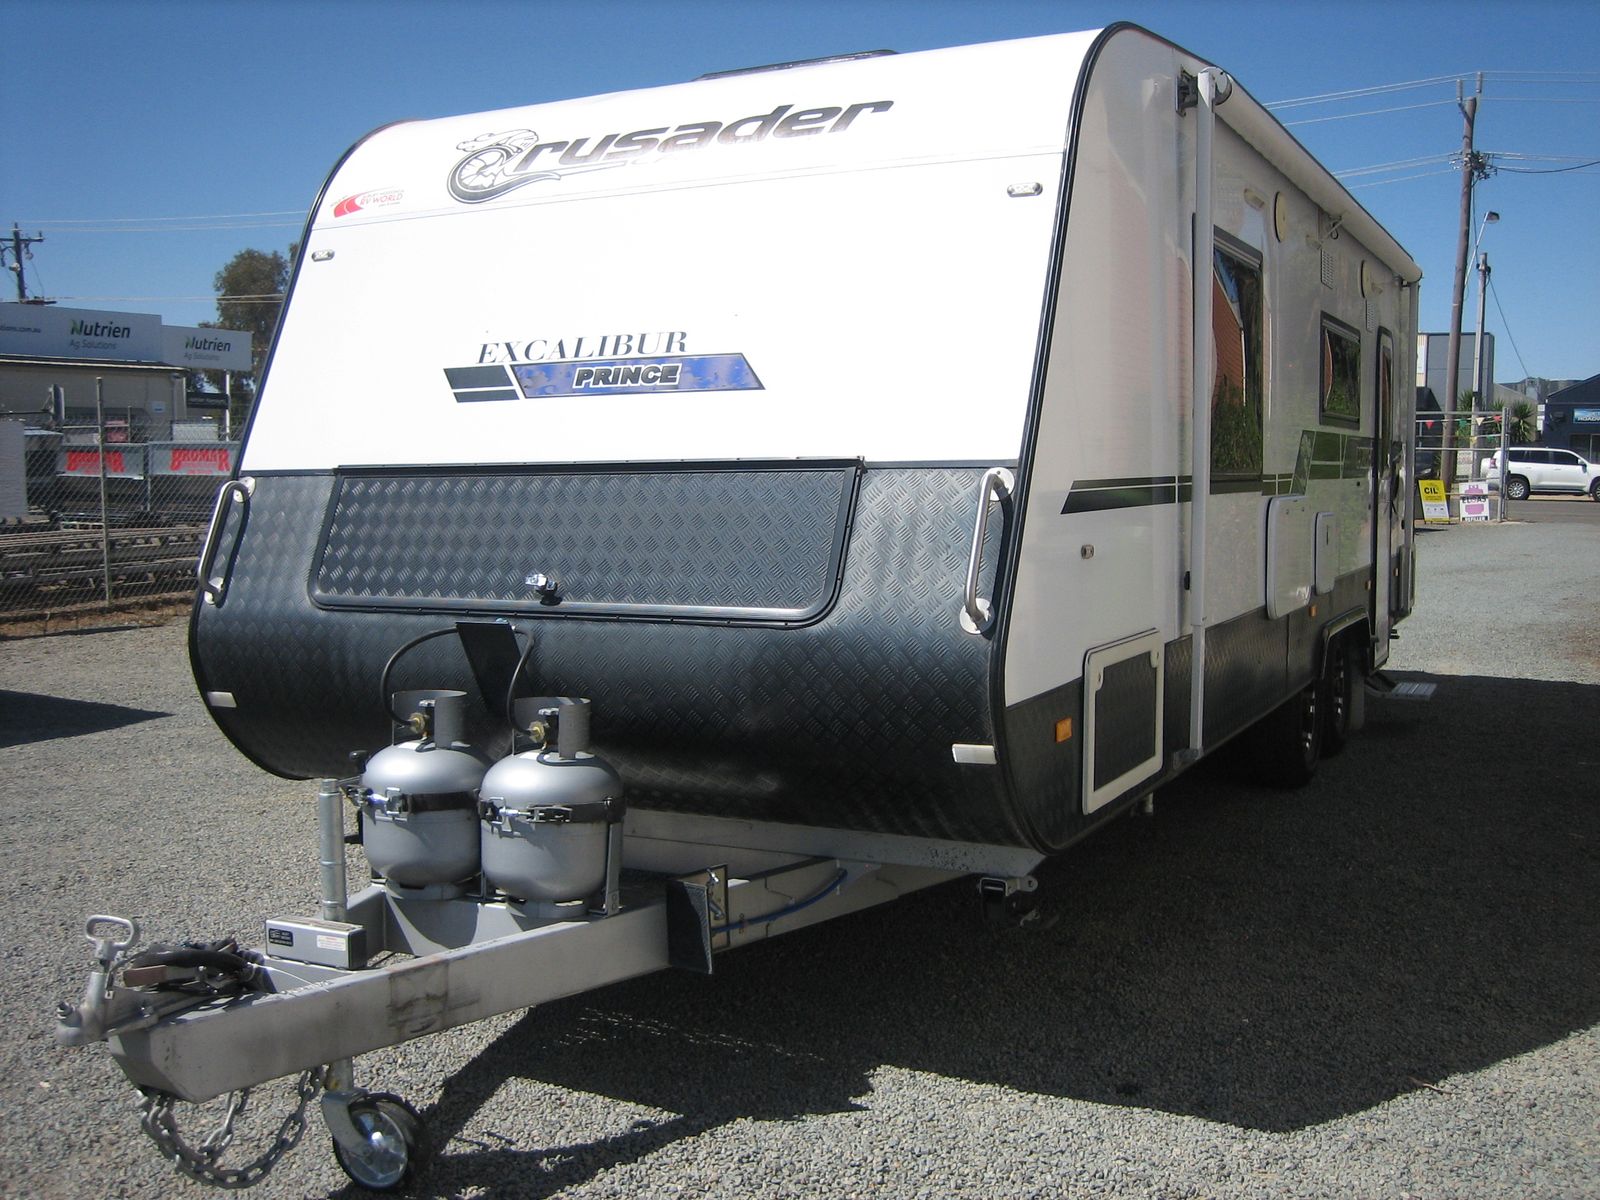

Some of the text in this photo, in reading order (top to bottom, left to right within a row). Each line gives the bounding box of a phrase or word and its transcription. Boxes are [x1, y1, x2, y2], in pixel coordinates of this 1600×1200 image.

[373, 193, 403, 204] WORLD
[70, 319, 131, 338] Nutrien
[185, 336, 231, 352] Nutrien
[475, 331, 688, 364] EXCALIBUR
[574, 365, 681, 387] PRINCE
